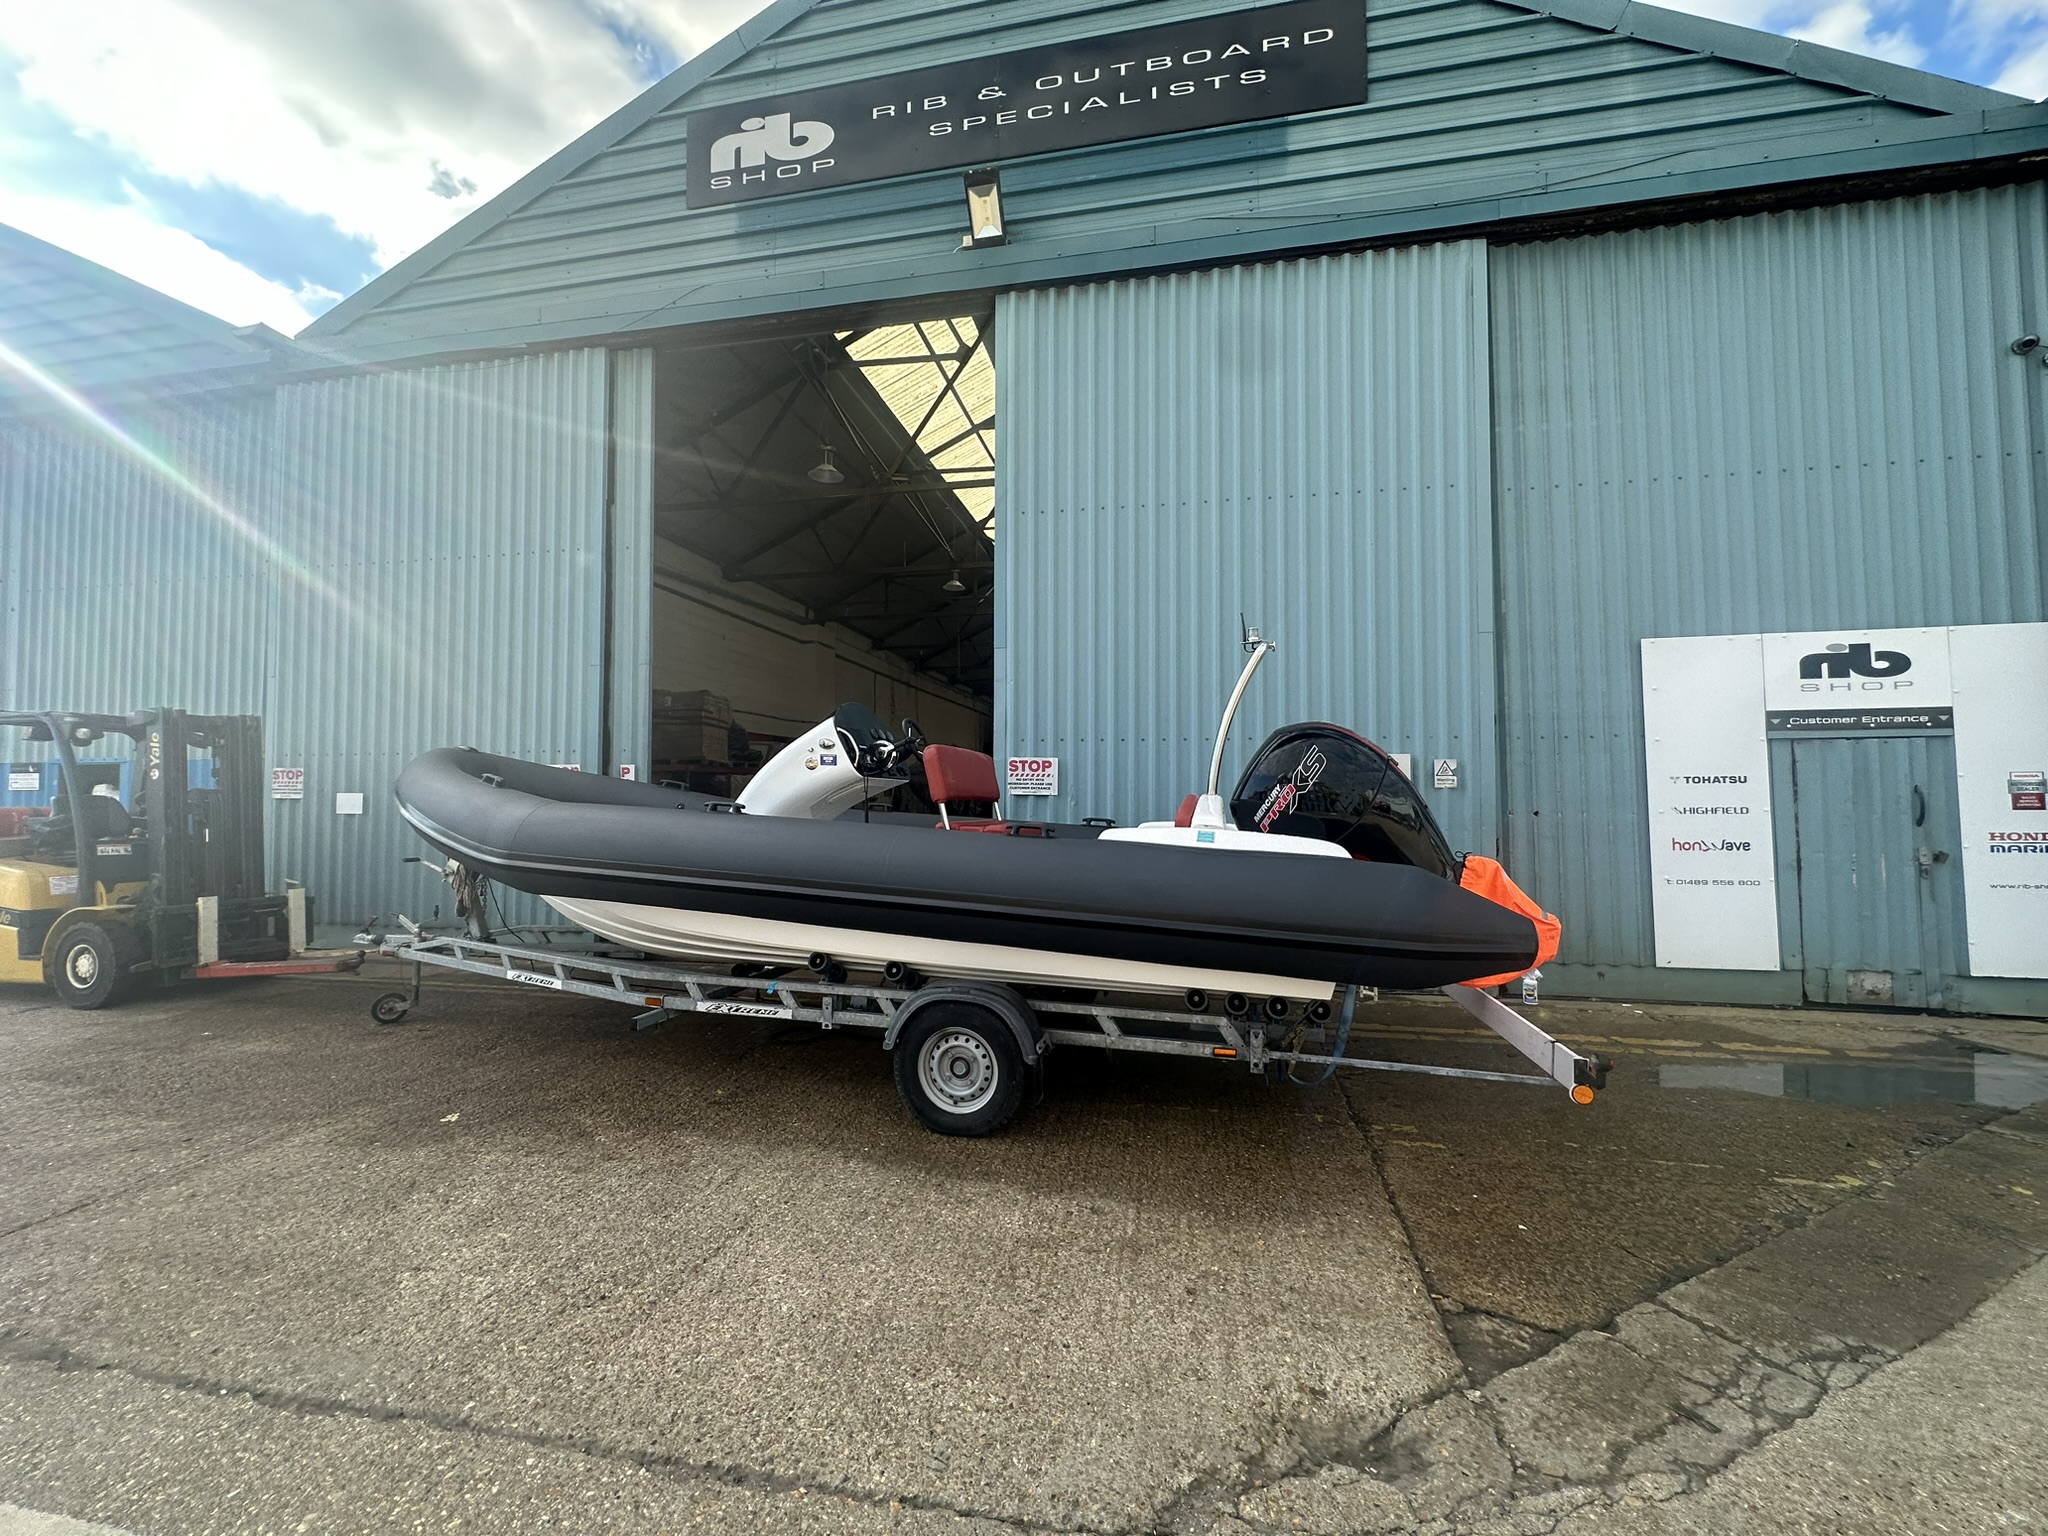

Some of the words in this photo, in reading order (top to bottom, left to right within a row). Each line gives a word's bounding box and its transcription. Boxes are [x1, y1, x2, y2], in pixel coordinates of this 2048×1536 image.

[872, 95, 948, 120] RIB
[977, 86, 1007, 100] &
[1035, 28, 1334, 90] OUTBOARD
[929, 69, 1267, 137] SPECIALISTS
[710, 112, 835, 173] rib
[710, 158, 835, 190] SHOP
[1799, 642, 1912, 679] rib
[1800, 680, 1913, 692] SHOP
[1789, 716, 1857, 726] Customer
[1861, 714, 1929, 724] Entrance
[150, 732, 160, 766] Yale
[1009, 760, 1052, 772] STOP
[273, 770, 303, 780] STOP
[1260, 784, 1296, 832] PRO
[1289, 745, 1326, 814] XS
[1683, 776, 1747, 784] TOHATSU
[1254, 784, 1281, 822] MERCURY
